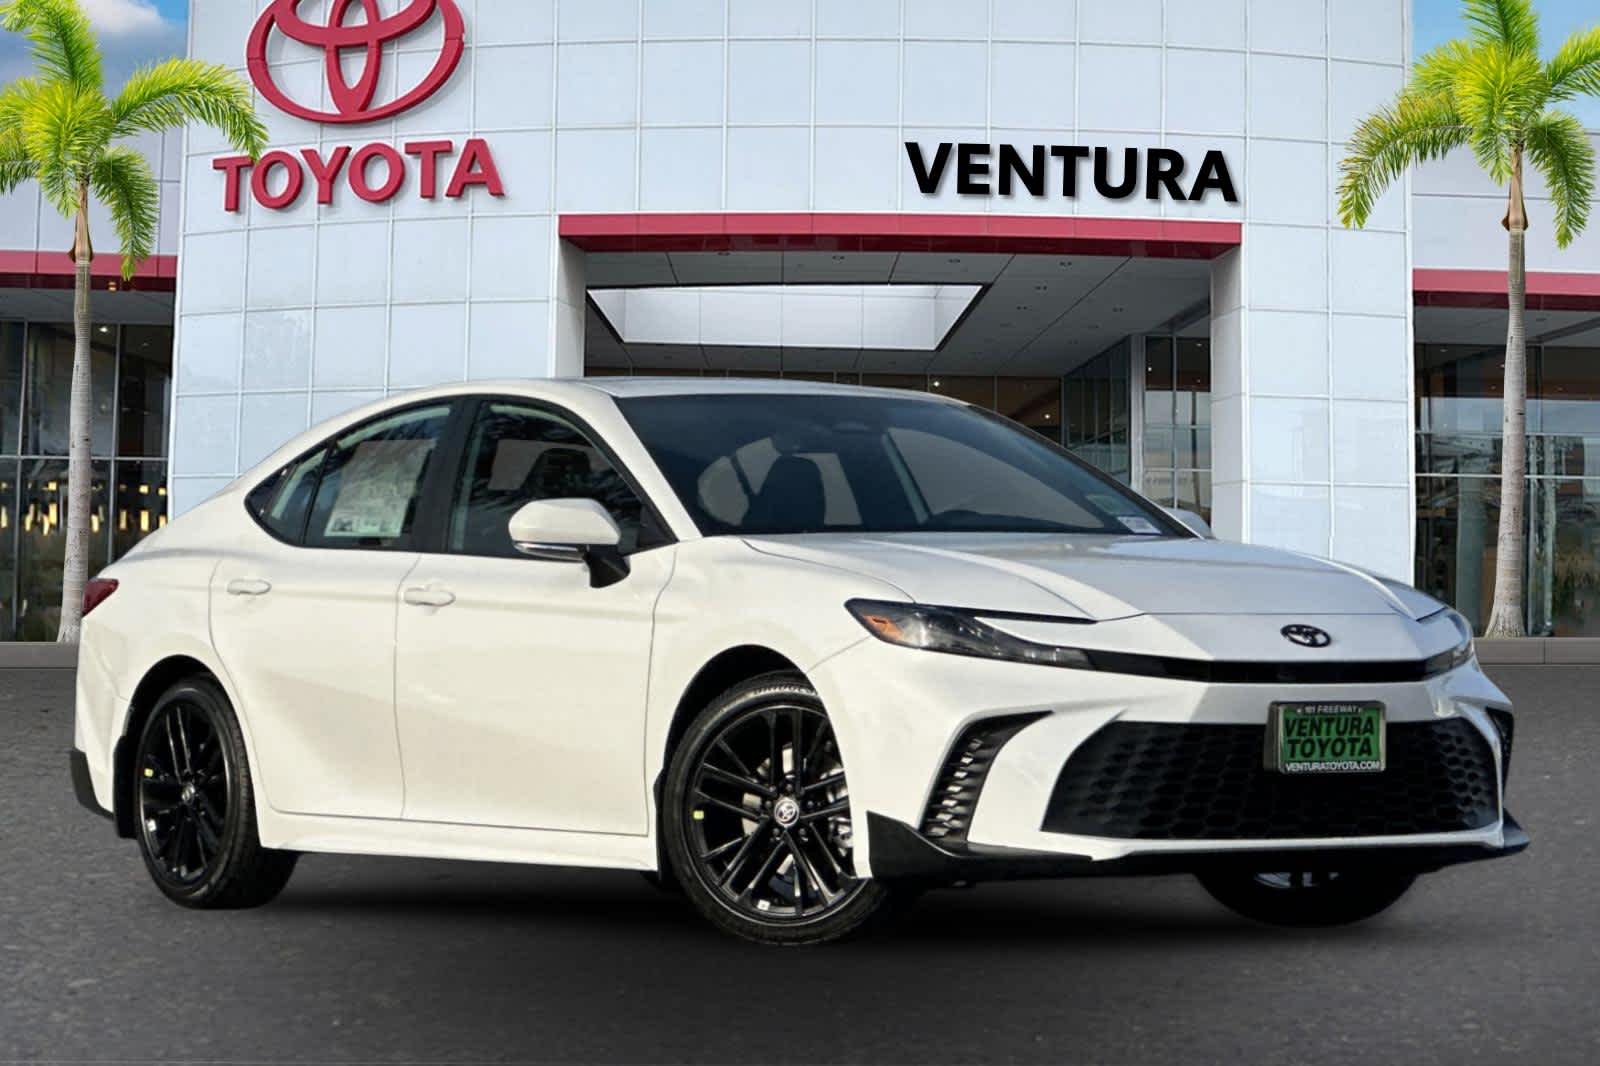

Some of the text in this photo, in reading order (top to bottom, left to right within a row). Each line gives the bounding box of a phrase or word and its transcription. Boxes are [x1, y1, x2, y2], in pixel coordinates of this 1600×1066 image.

[213, 138, 505, 212] TOYOTA
[905, 141, 1238, 202] VENTURA
[1318, 705, 1357, 713] FREEWAY
[1284, 716, 1374, 737] VENTURA
[1287, 737, 1373, 758] TOYOTA
[1286, 761, 1379, 771] VENTURATOYOTA.COM
